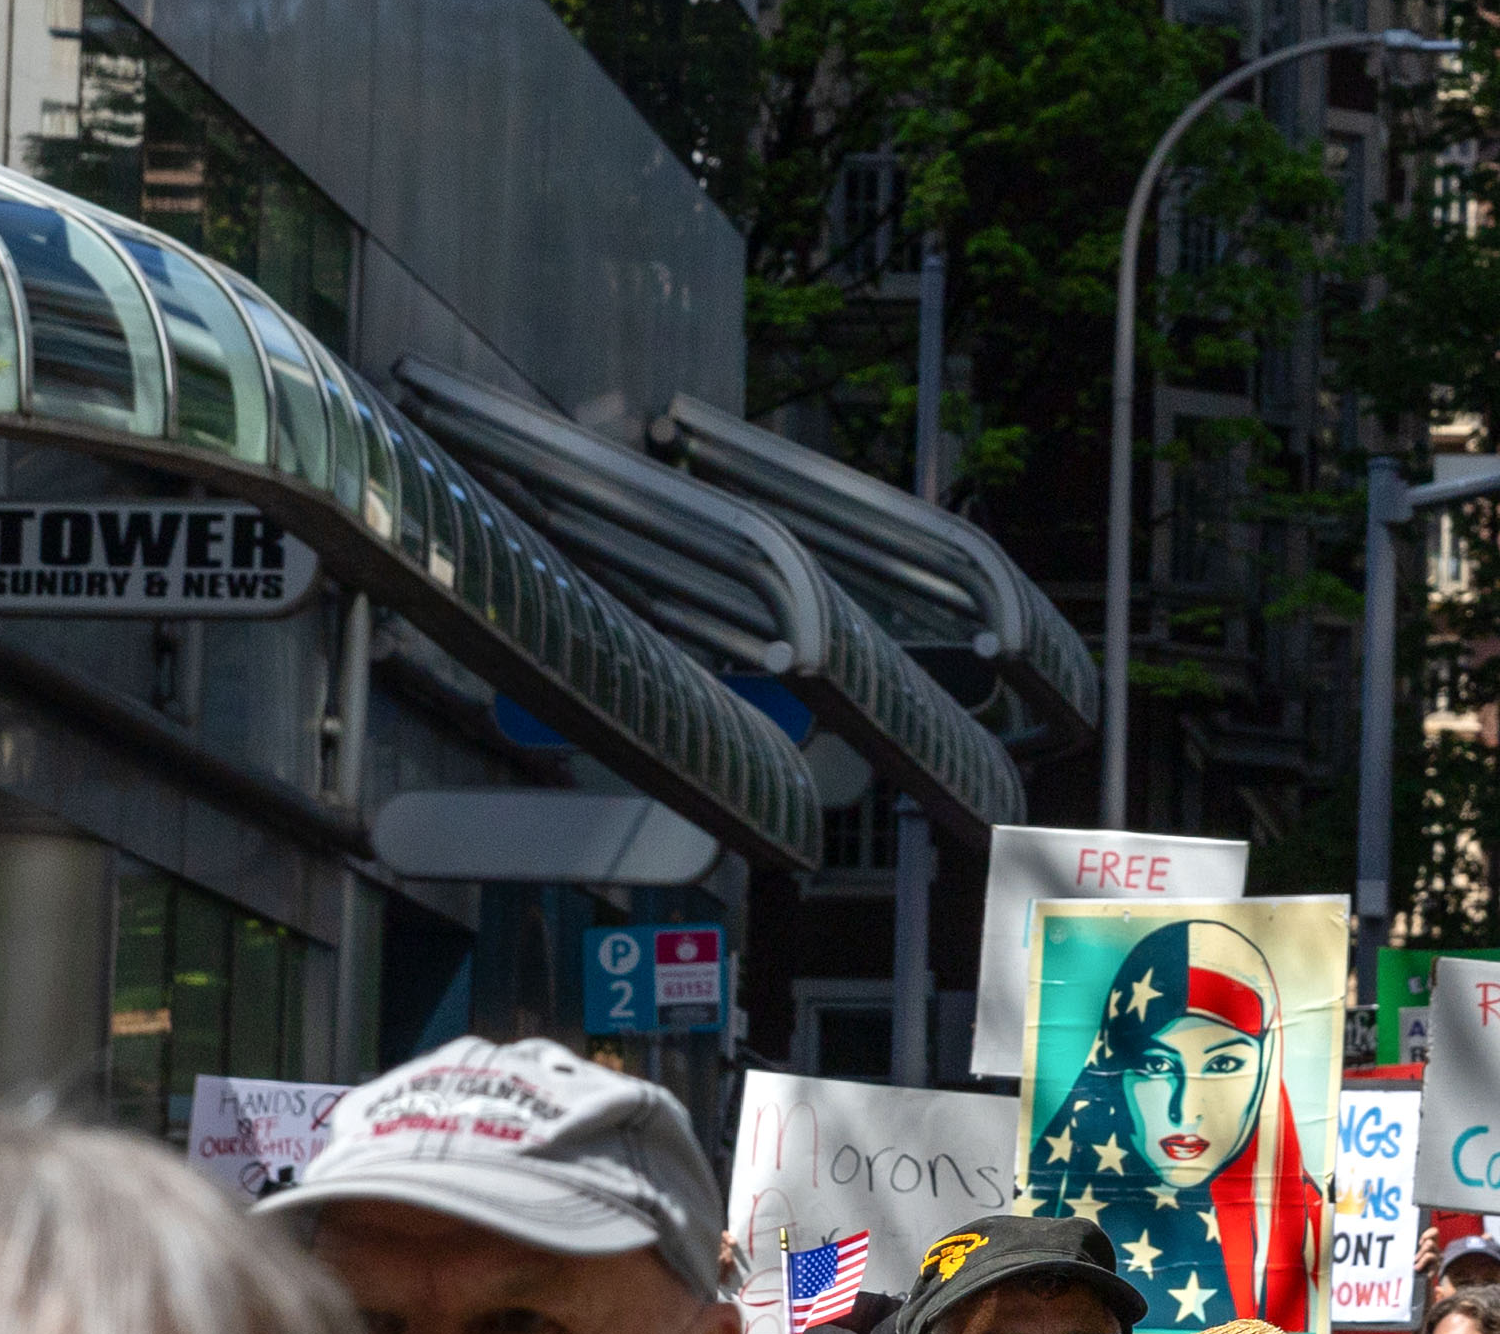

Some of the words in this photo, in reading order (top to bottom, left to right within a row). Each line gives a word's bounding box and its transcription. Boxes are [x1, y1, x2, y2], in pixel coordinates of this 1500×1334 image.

[143, 572, 170, 598] &
[182, 572, 285, 600] NEWS
[1076, 848, 1172, 892] FREE
[609, 980, 636, 1018] 2
[219, 1088, 307, 1118] HANDS
[1331, 1277, 1403, 1308] OWN!
